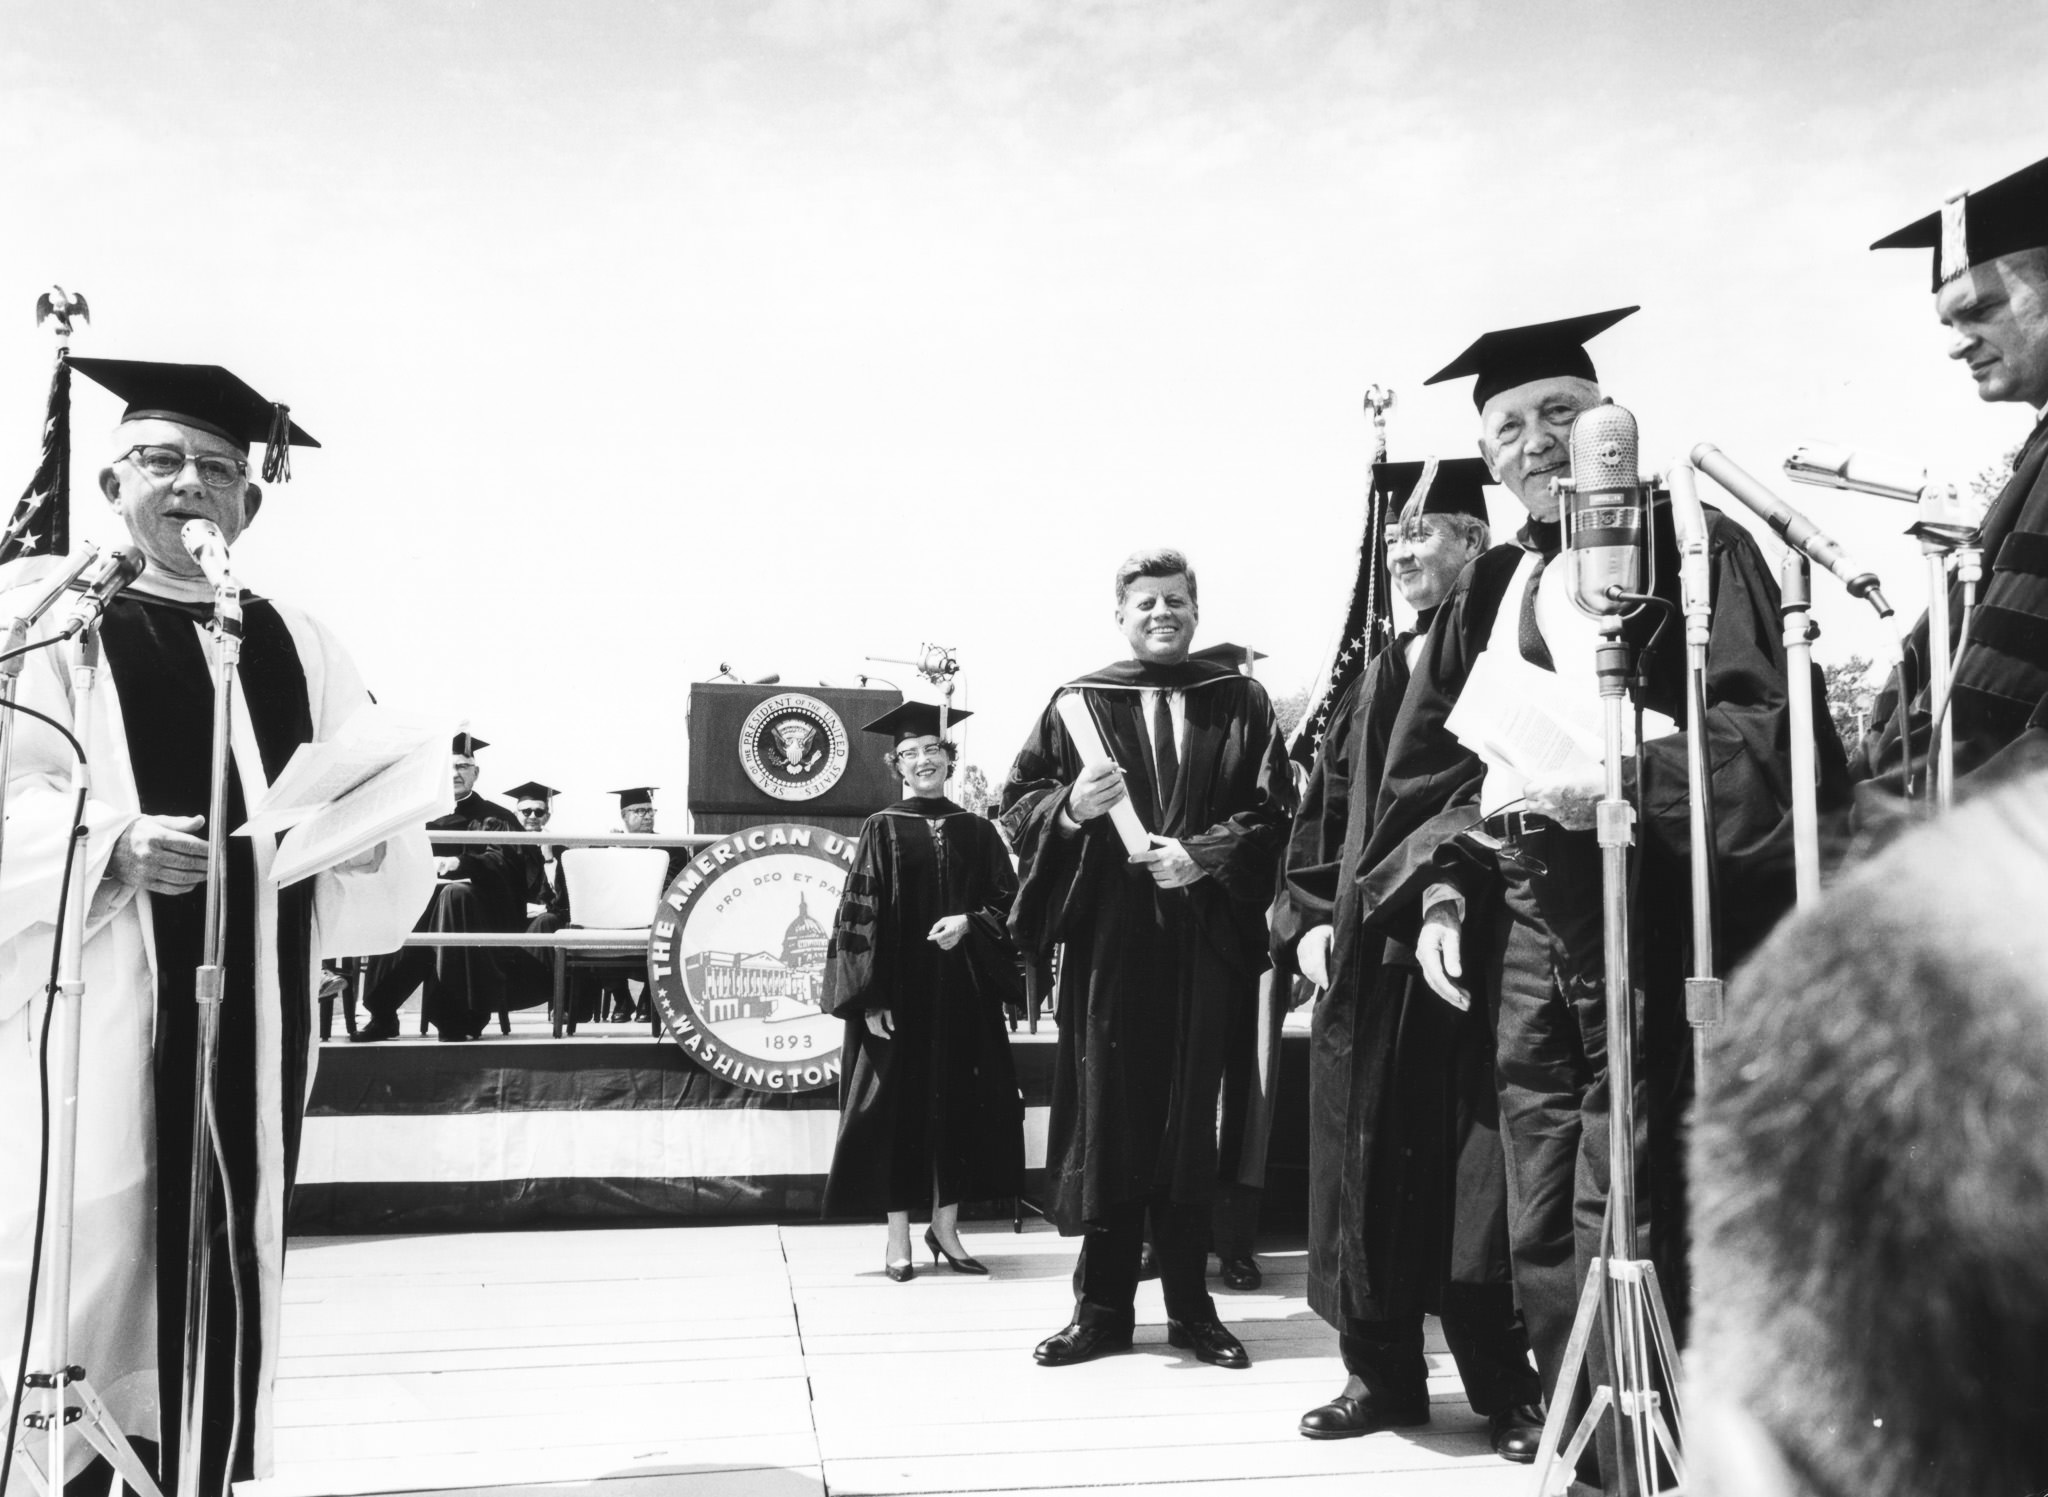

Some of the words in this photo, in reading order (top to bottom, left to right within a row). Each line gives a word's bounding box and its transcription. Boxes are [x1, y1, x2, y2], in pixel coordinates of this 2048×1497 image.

[795, 698, 804, 706] OF
[808, 701, 821, 712] THE
[744, 698, 791, 745] PRESIDENT
[823, 711, 845, 757] UNITED
[744, 749, 753, 762] THE
[748, 765, 758, 775] OF
[804, 766, 840, 796] STATES
[758, 778, 784, 796] SEAL
[653, 921, 676, 981] THE
[667, 828, 812, 912] AMERICAN
[716, 887, 742, 913] PRO
[753, 872, 782, 887] DEO
[793, 872, 813, 884] ET
[672, 1014, 841, 1089] WASHINGTON
[765, 1034, 813, 1049] 1893
